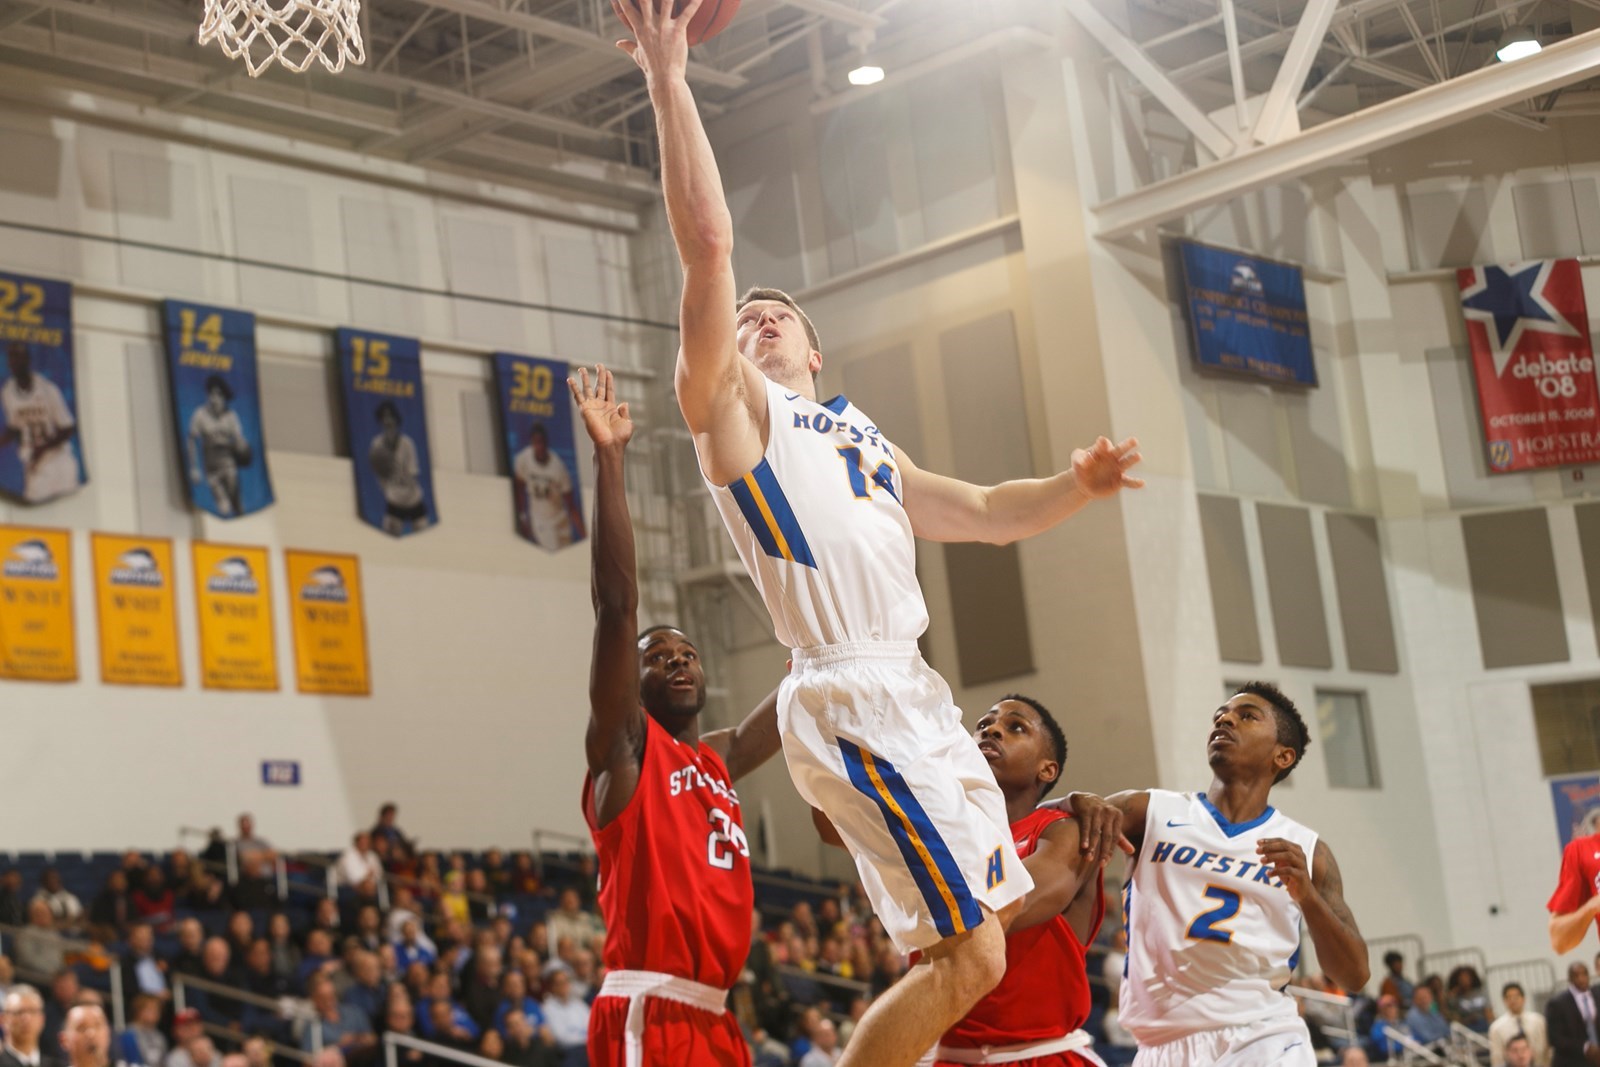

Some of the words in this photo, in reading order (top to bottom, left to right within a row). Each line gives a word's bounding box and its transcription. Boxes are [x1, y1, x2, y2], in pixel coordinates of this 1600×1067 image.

[0, 279, 44, 324] 22
[180, 309, 225, 350] 14
[351, 336, 390, 376] 15
[1512, 352, 1593, 380] debate
[510, 361, 553, 400] 30
[1534, 375, 1577, 399] '08
[1489, 411, 1546, 428] OCTOBER
[985, 844, 1007, 894] H
[1150, 841, 1284, 889] HOFSTR
[1184, 883, 1244, 946] 2
